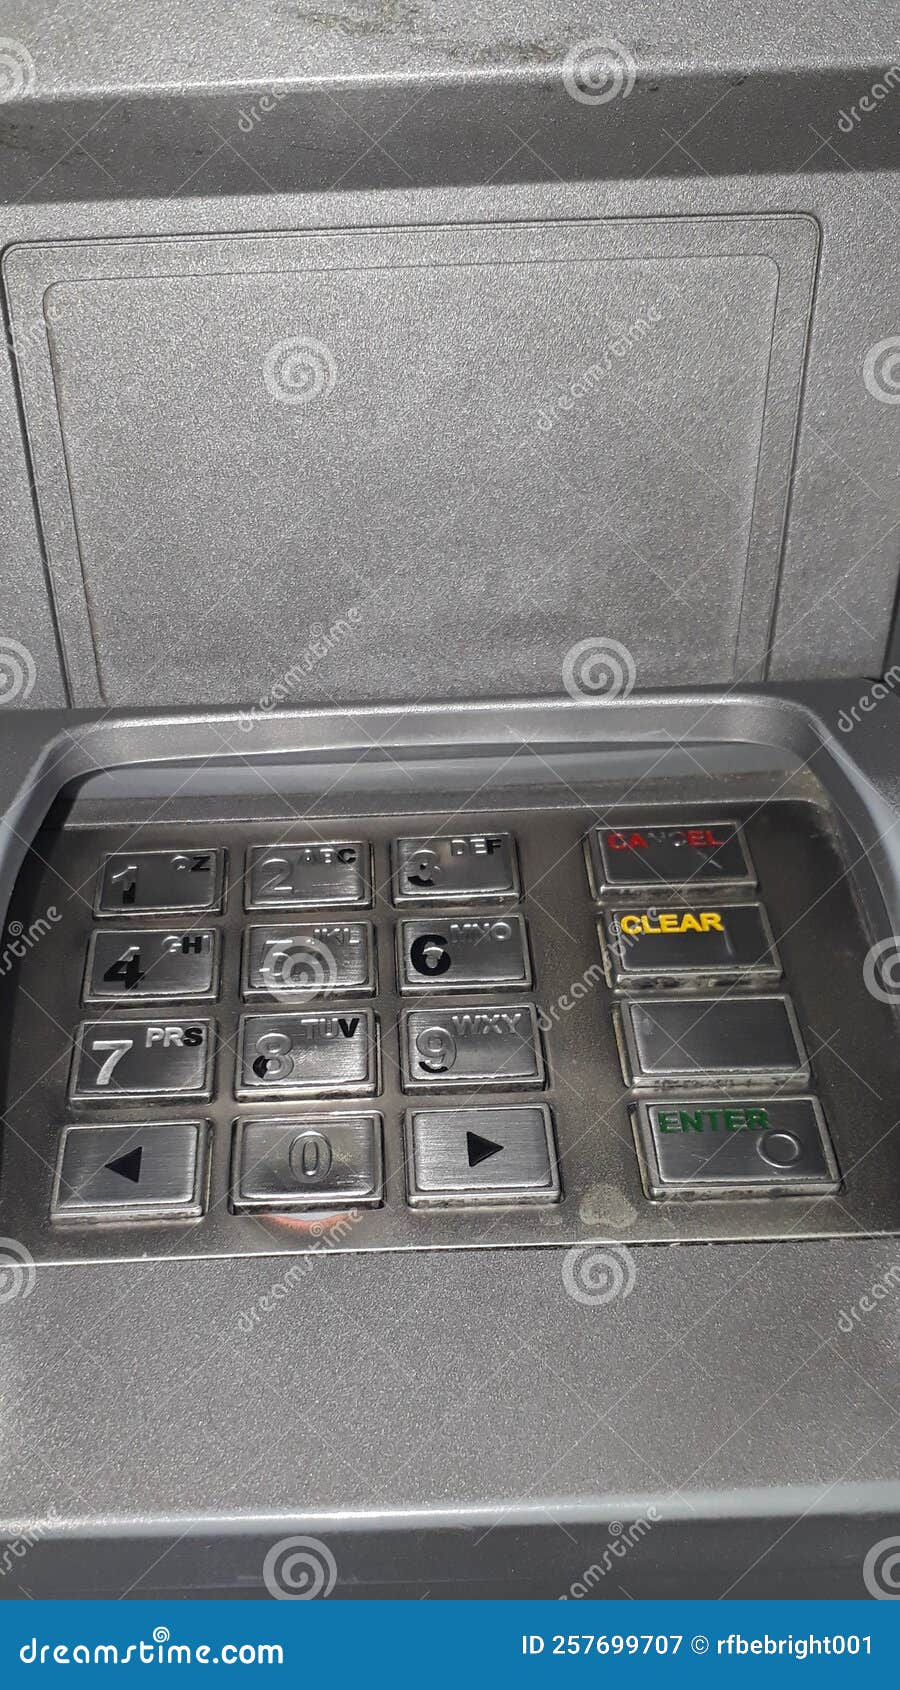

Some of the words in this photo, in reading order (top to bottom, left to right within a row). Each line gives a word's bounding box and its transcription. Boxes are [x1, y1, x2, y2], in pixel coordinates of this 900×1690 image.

[607, 830, 725, 850] CANCEL
[258, 858, 293, 895] 2
[407, 849, 440, 887] 3
[450, 838, 501, 855] DEF
[112, 866, 136, 904] 1
[620, 912, 724, 935] CLEAR
[103, 946, 145, 989] 4
[411, 934, 451, 976] 6
[92, 1040, 133, 1085] 7
[146, 1026, 203, 1048] PRS
[252, 1032, 294, 1081] 8
[301, 1017, 360, 1039] TUV
[416, 1026, 456, 1074] 9
[452, 1013, 521, 1036] WXY
[657, 1107, 771, 1135] ENTER
[288, 1130, 333, 1184] 0
